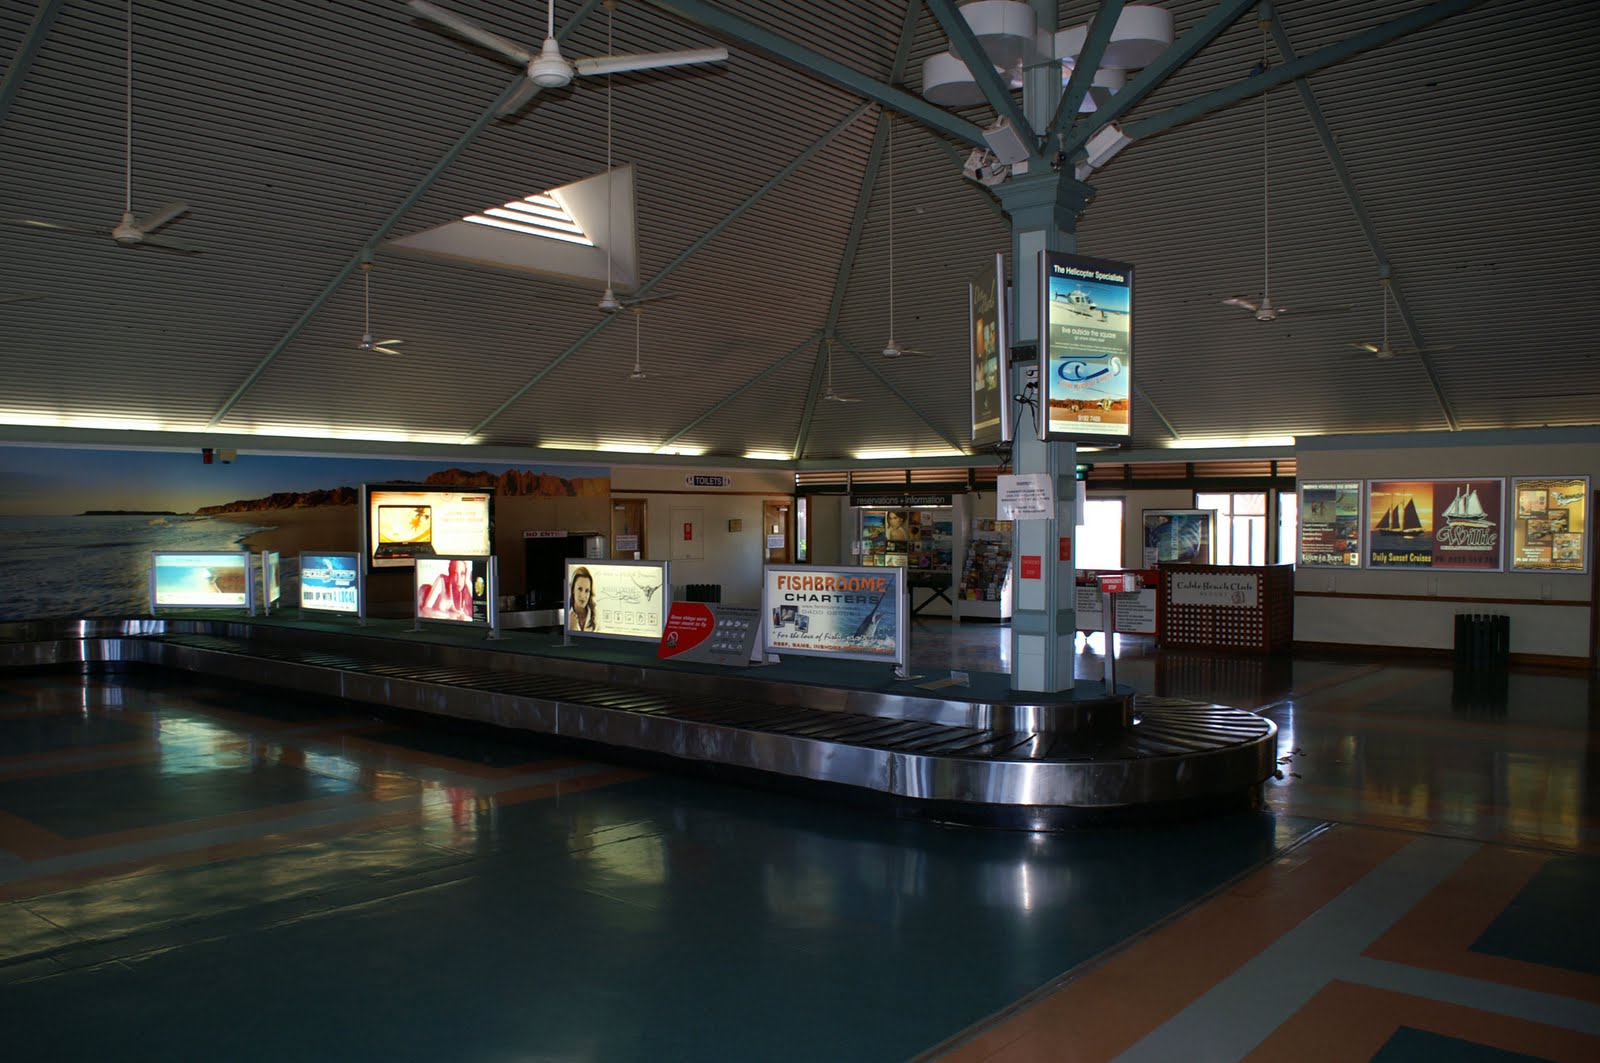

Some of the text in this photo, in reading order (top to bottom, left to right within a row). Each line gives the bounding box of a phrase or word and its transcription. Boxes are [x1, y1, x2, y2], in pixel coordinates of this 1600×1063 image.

[1053, 264, 1125, 283] The Helicopter Specialists
[1071, 328, 1090, 336] outside
[1090, 329, 1099, 337] the
[1099, 332, 1117, 340] square
[695, 476, 723, 486] TOILETS
[856, 495, 898, 505] reservations
[904, 495, 945, 504] information
[1436, 525, 1498, 546] Willie
[1372, 552, 1432, 564] Daily Sunset Cruises
[777, 575, 888, 593] FISHBROOME
[1177, 581, 1253, 591] Cable Beach Club
[784, 593, 880, 605] CHARTERS
[800, 632, 816, 640] love
[816, 633, 824, 642] of
